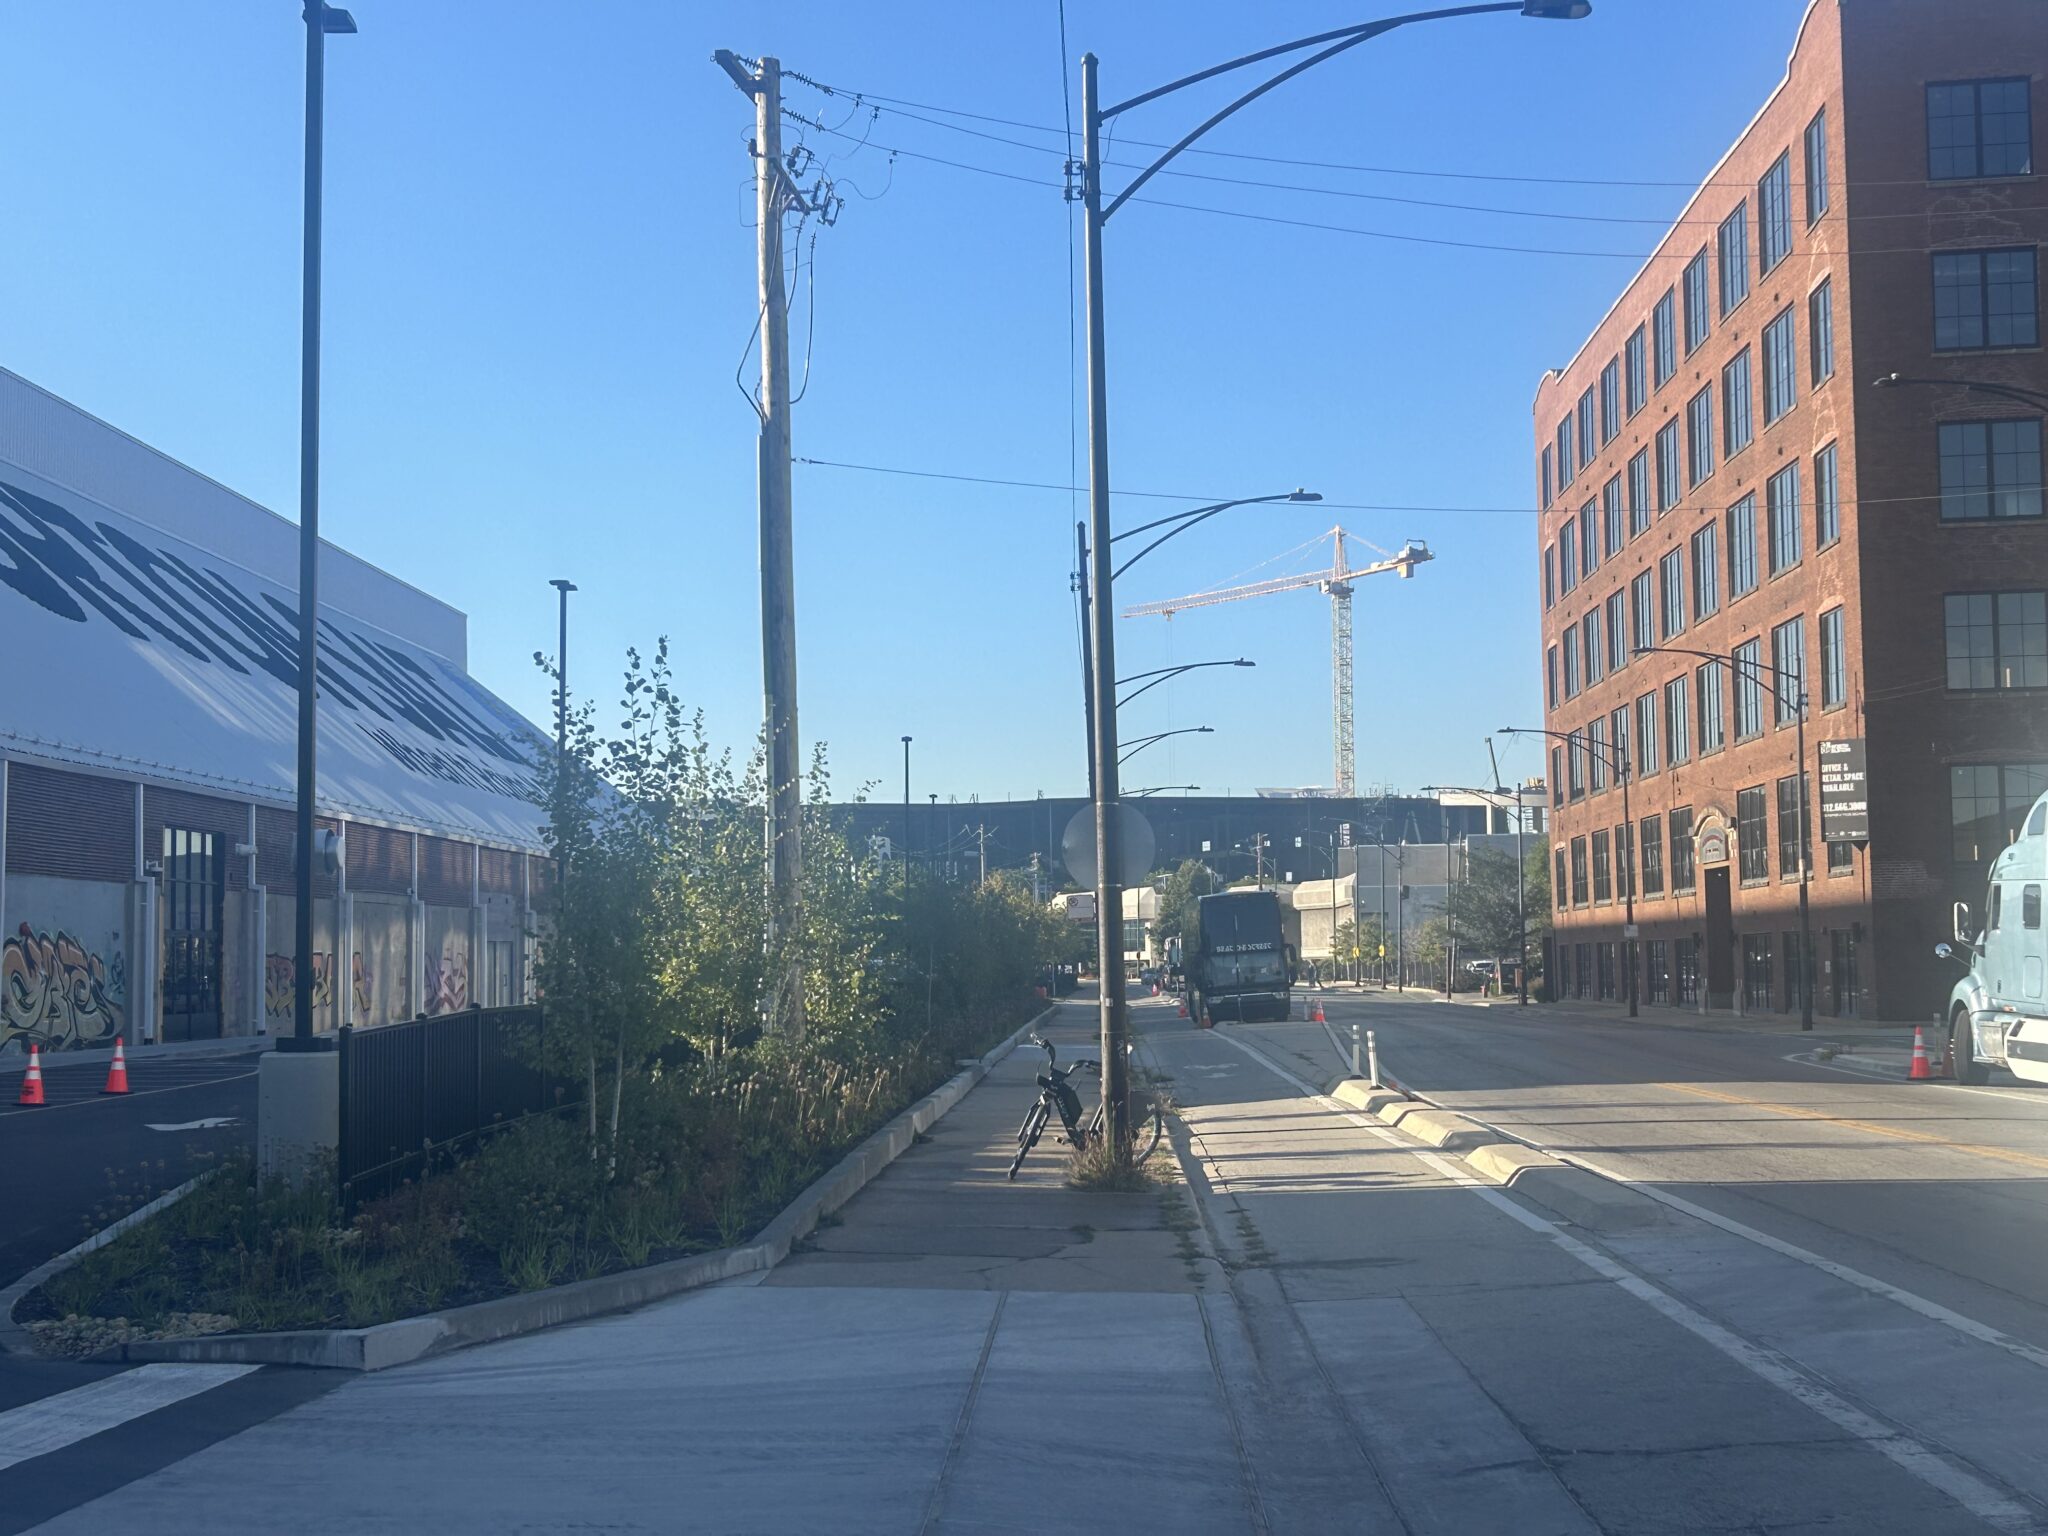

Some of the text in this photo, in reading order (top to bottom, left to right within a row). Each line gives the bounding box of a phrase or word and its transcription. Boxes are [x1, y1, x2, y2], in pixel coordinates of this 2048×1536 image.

[260, 592, 540, 768] SALT
[353, 721, 477, 789] When
[434, 746, 495, 793] It
[1822, 763, 1841, 773] OFFICE
[1822, 772, 1864, 783] RETAIL SPACE
[1822, 782, 1855, 792] AVAILABLE
